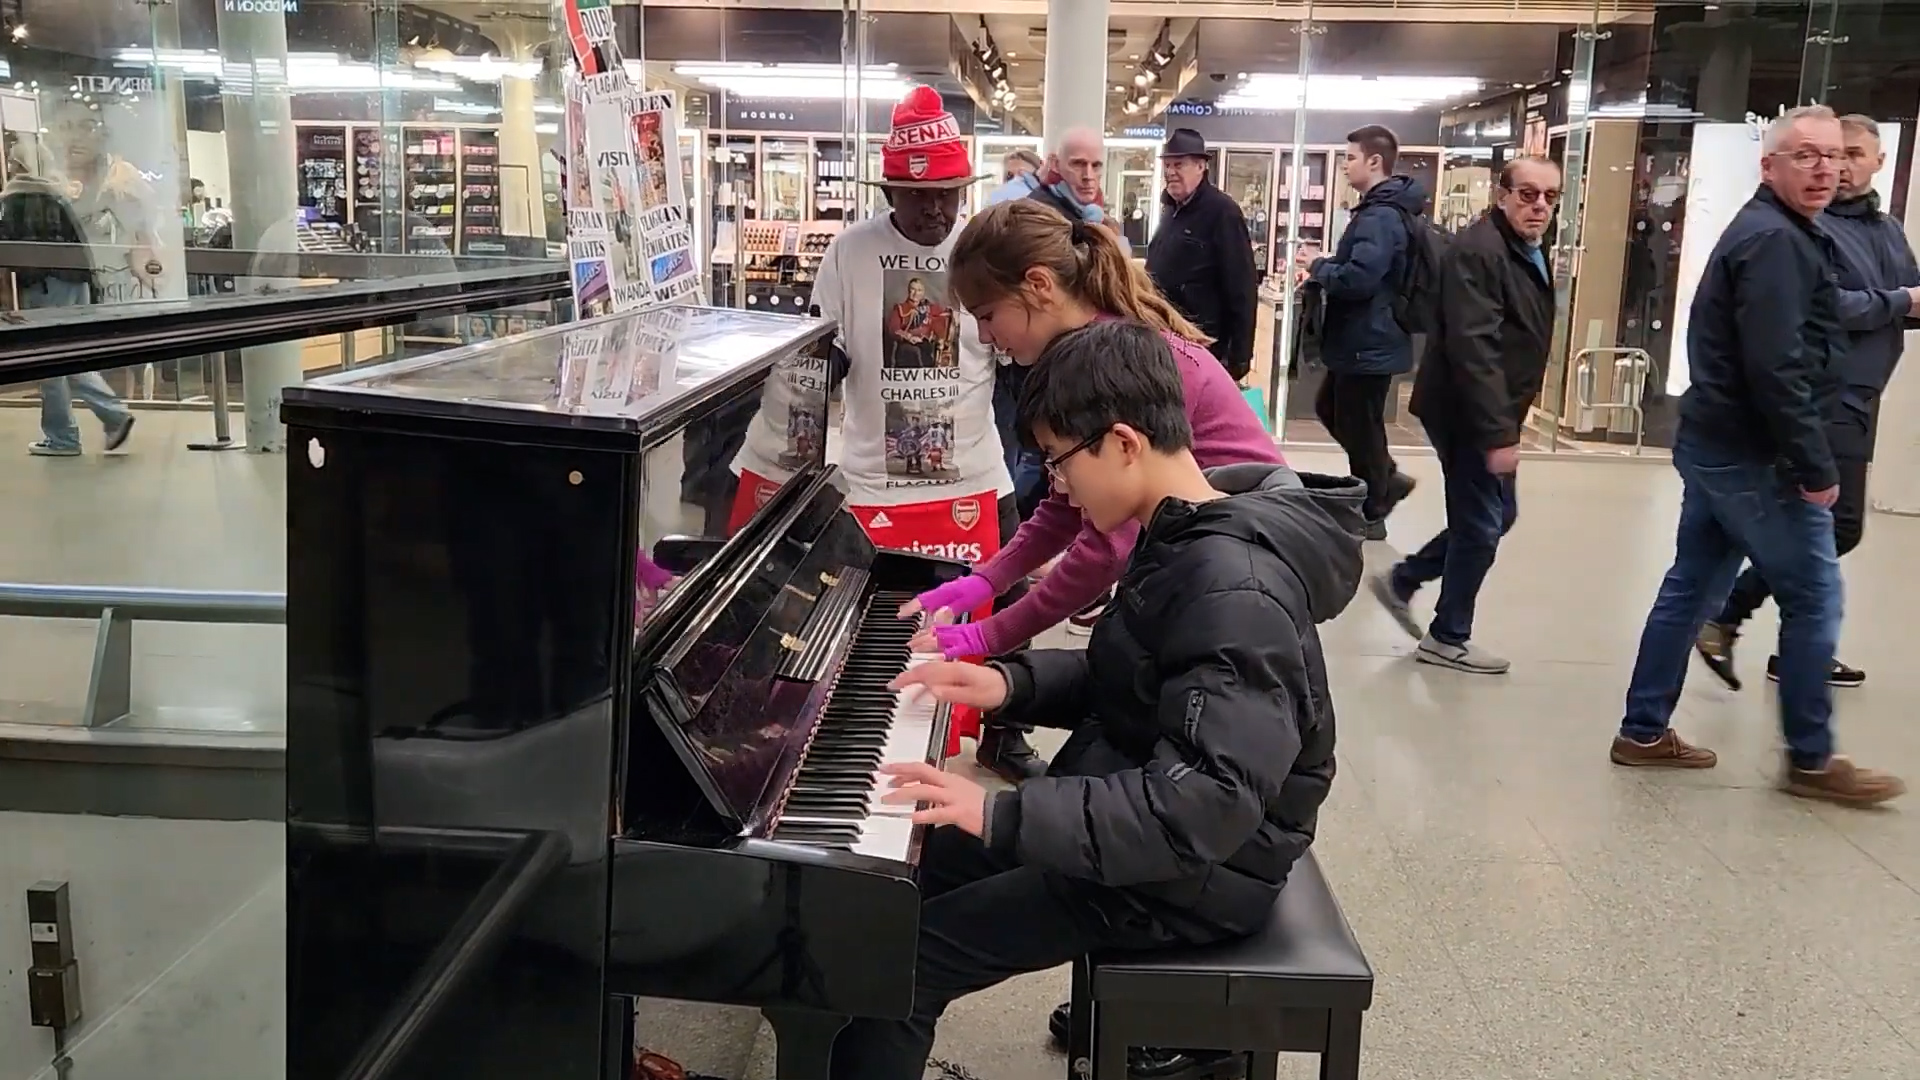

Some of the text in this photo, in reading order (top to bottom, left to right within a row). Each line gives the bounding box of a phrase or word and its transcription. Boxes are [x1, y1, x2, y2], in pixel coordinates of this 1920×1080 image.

[623, 94, 673, 116] QUEEN
[597, 151, 631, 168] VISIT
[879, 254, 949, 272] WE LO
[654, 274, 701, 302] WE LOVE
[880, 367, 961, 383] NEW KING
[880, 386, 946, 401] CHARLES
[876, 540, 982, 561] irates
